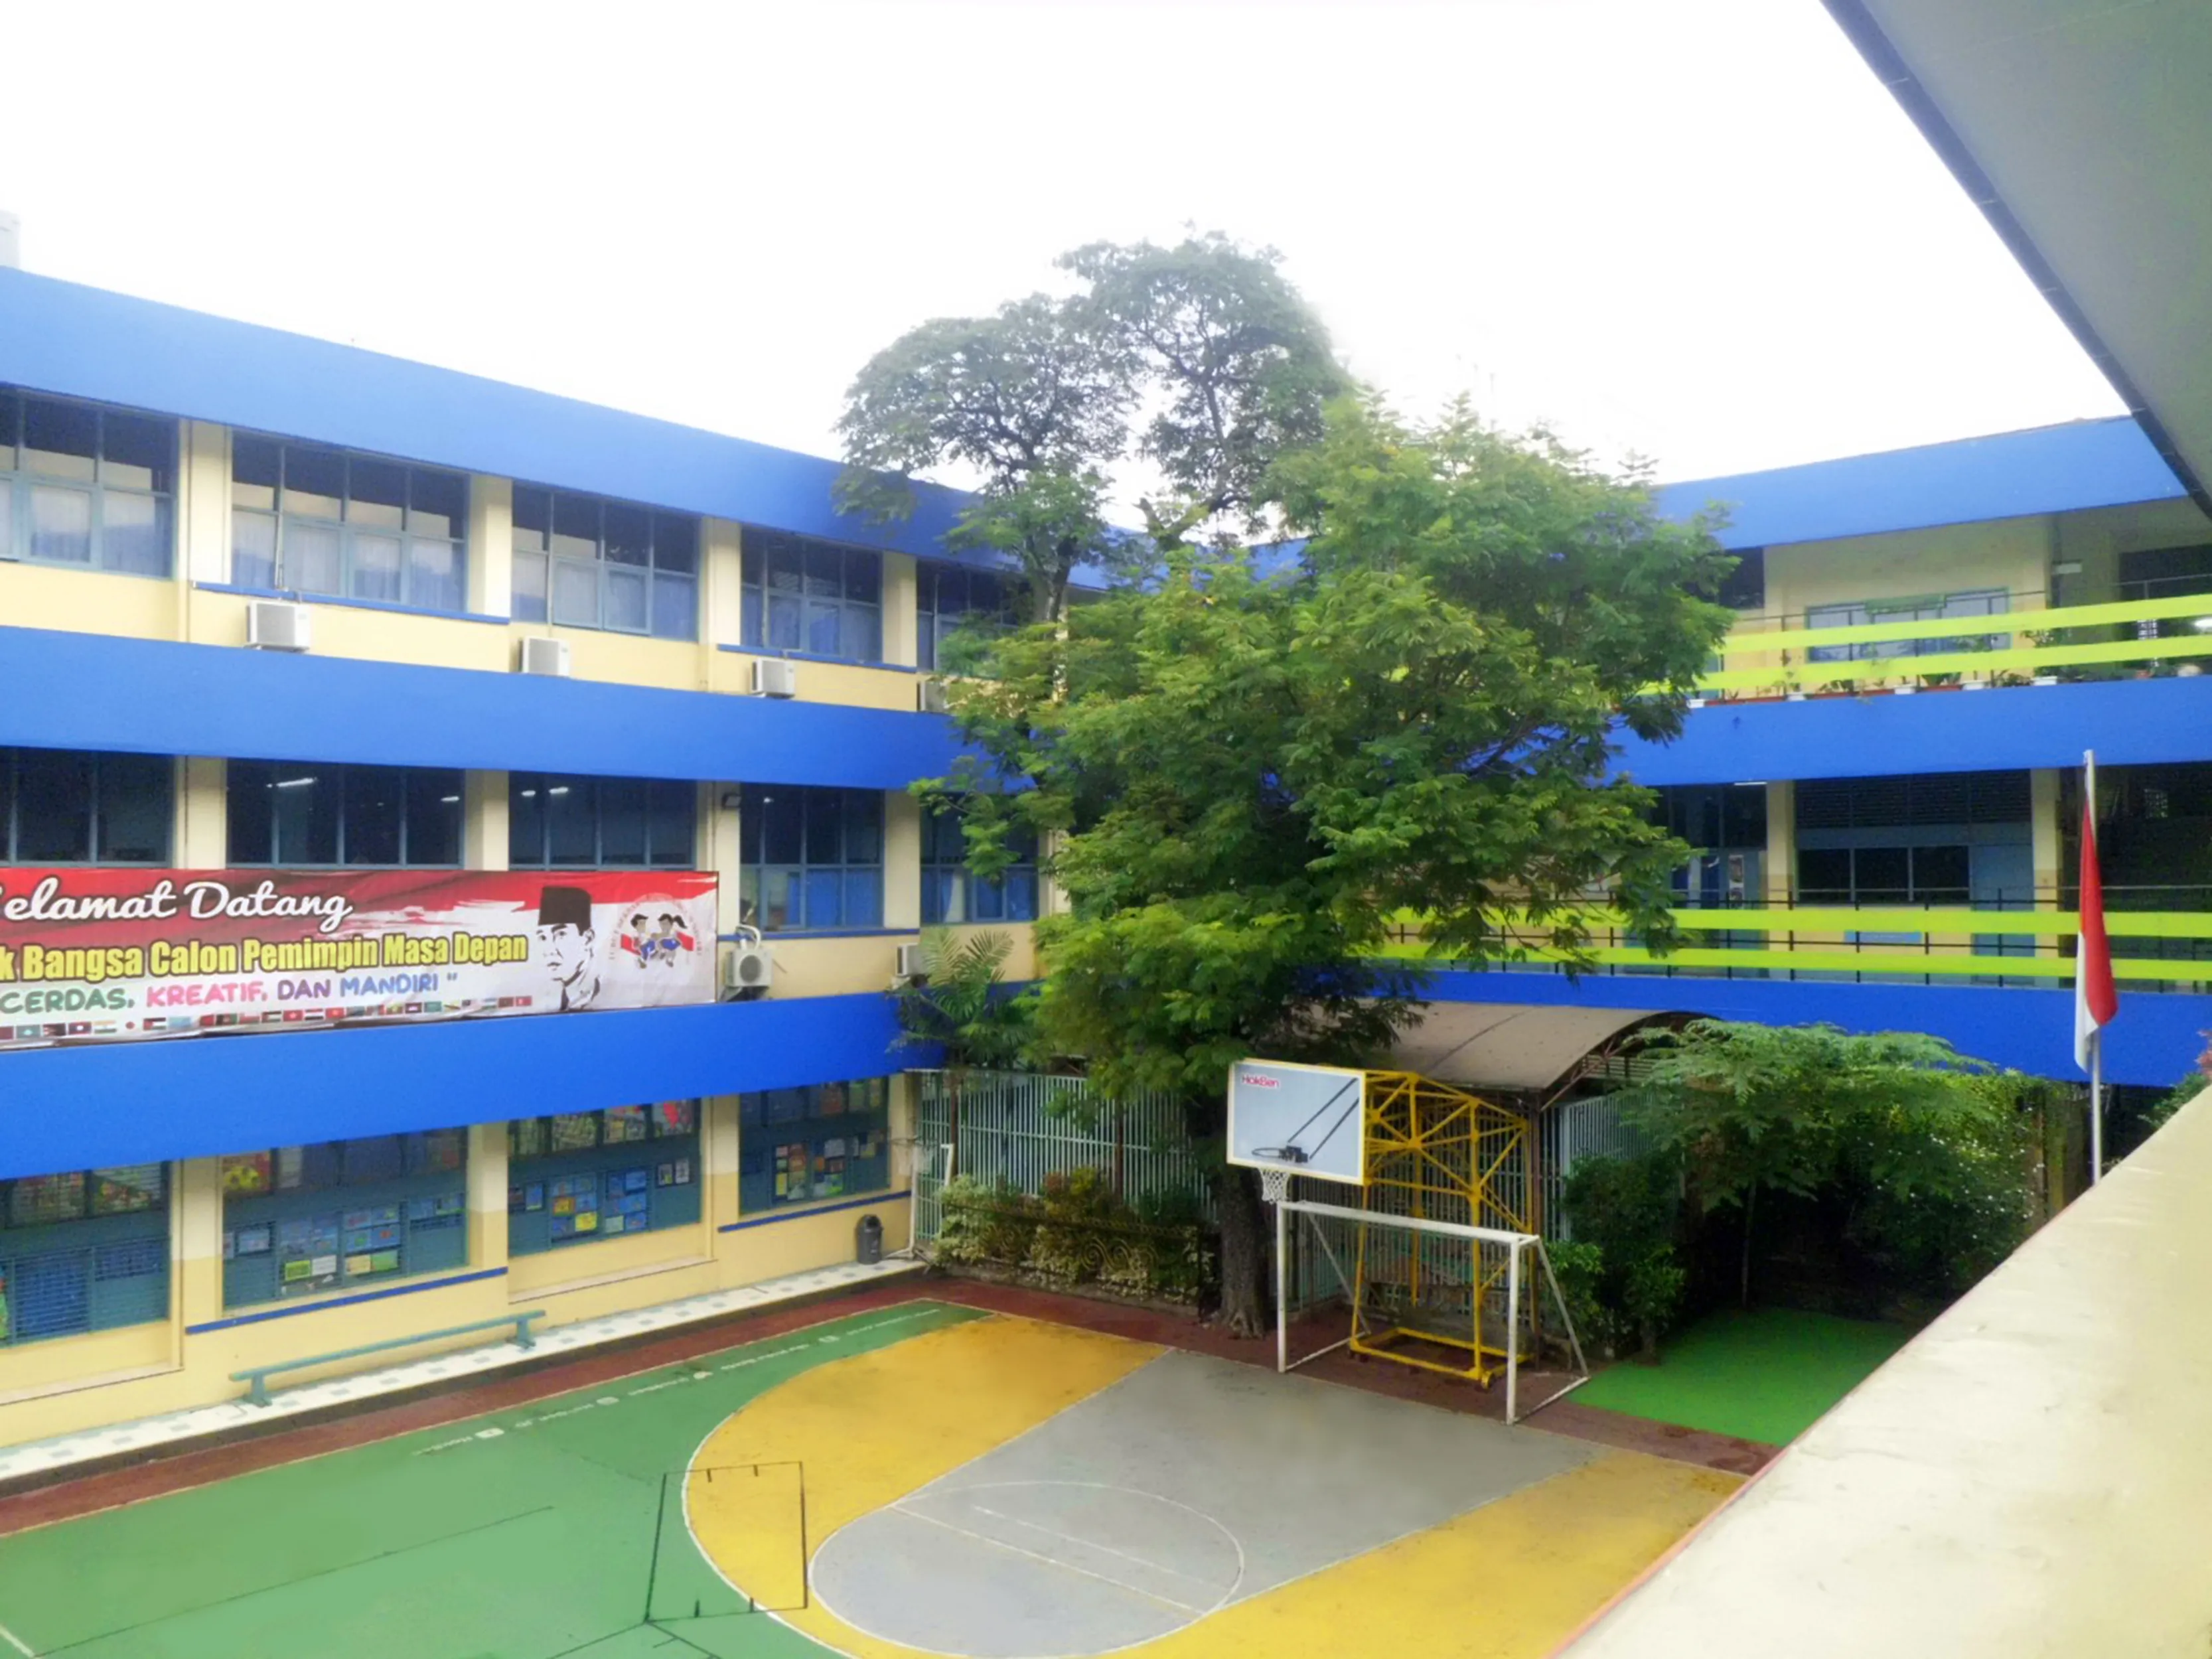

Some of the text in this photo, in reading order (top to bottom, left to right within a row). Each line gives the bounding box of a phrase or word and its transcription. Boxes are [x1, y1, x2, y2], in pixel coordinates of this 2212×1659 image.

[0, 876, 353, 933] elamat Datang
[23, 944, 143, 983] Bangsa
[150, 939, 236, 975] Calon
[242, 935, 378, 972] Pemimpin
[382, 932, 449, 966] Masa
[453, 931, 528, 966] Depan
[146, 981, 268, 1009] KREATIF,
[277, 979, 331, 1001] DAN
[340, 972, 439, 997] MANDIRI
